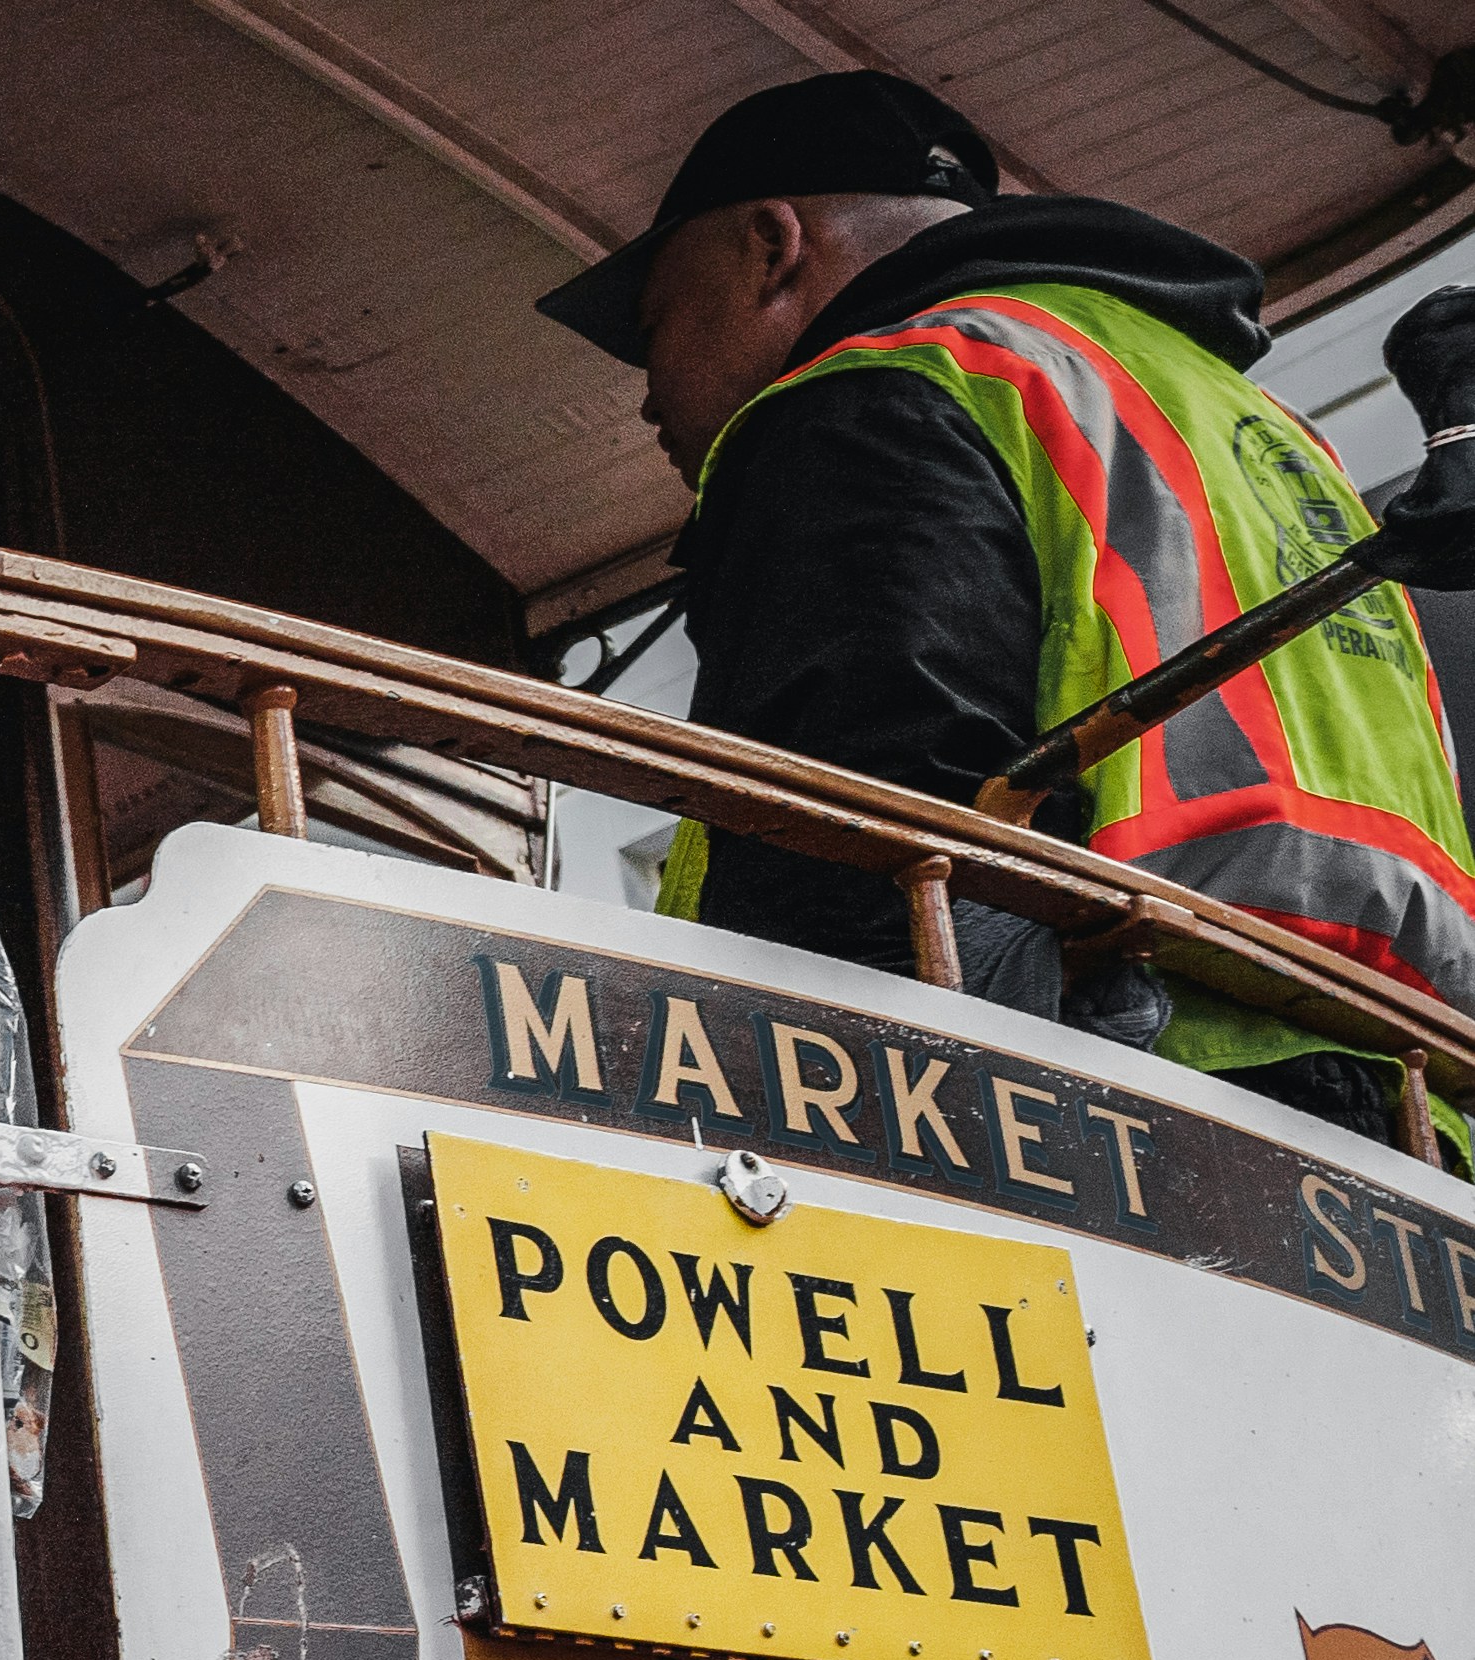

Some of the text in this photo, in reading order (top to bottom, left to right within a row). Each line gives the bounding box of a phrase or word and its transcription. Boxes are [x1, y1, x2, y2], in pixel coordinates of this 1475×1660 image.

[476, 955, 1159, 1232] MARKET
[485, 1217, 1065, 1408] POWELL
[670, 1376, 941, 1480] AND
[505, 1439, 1102, 1617] MARKET
